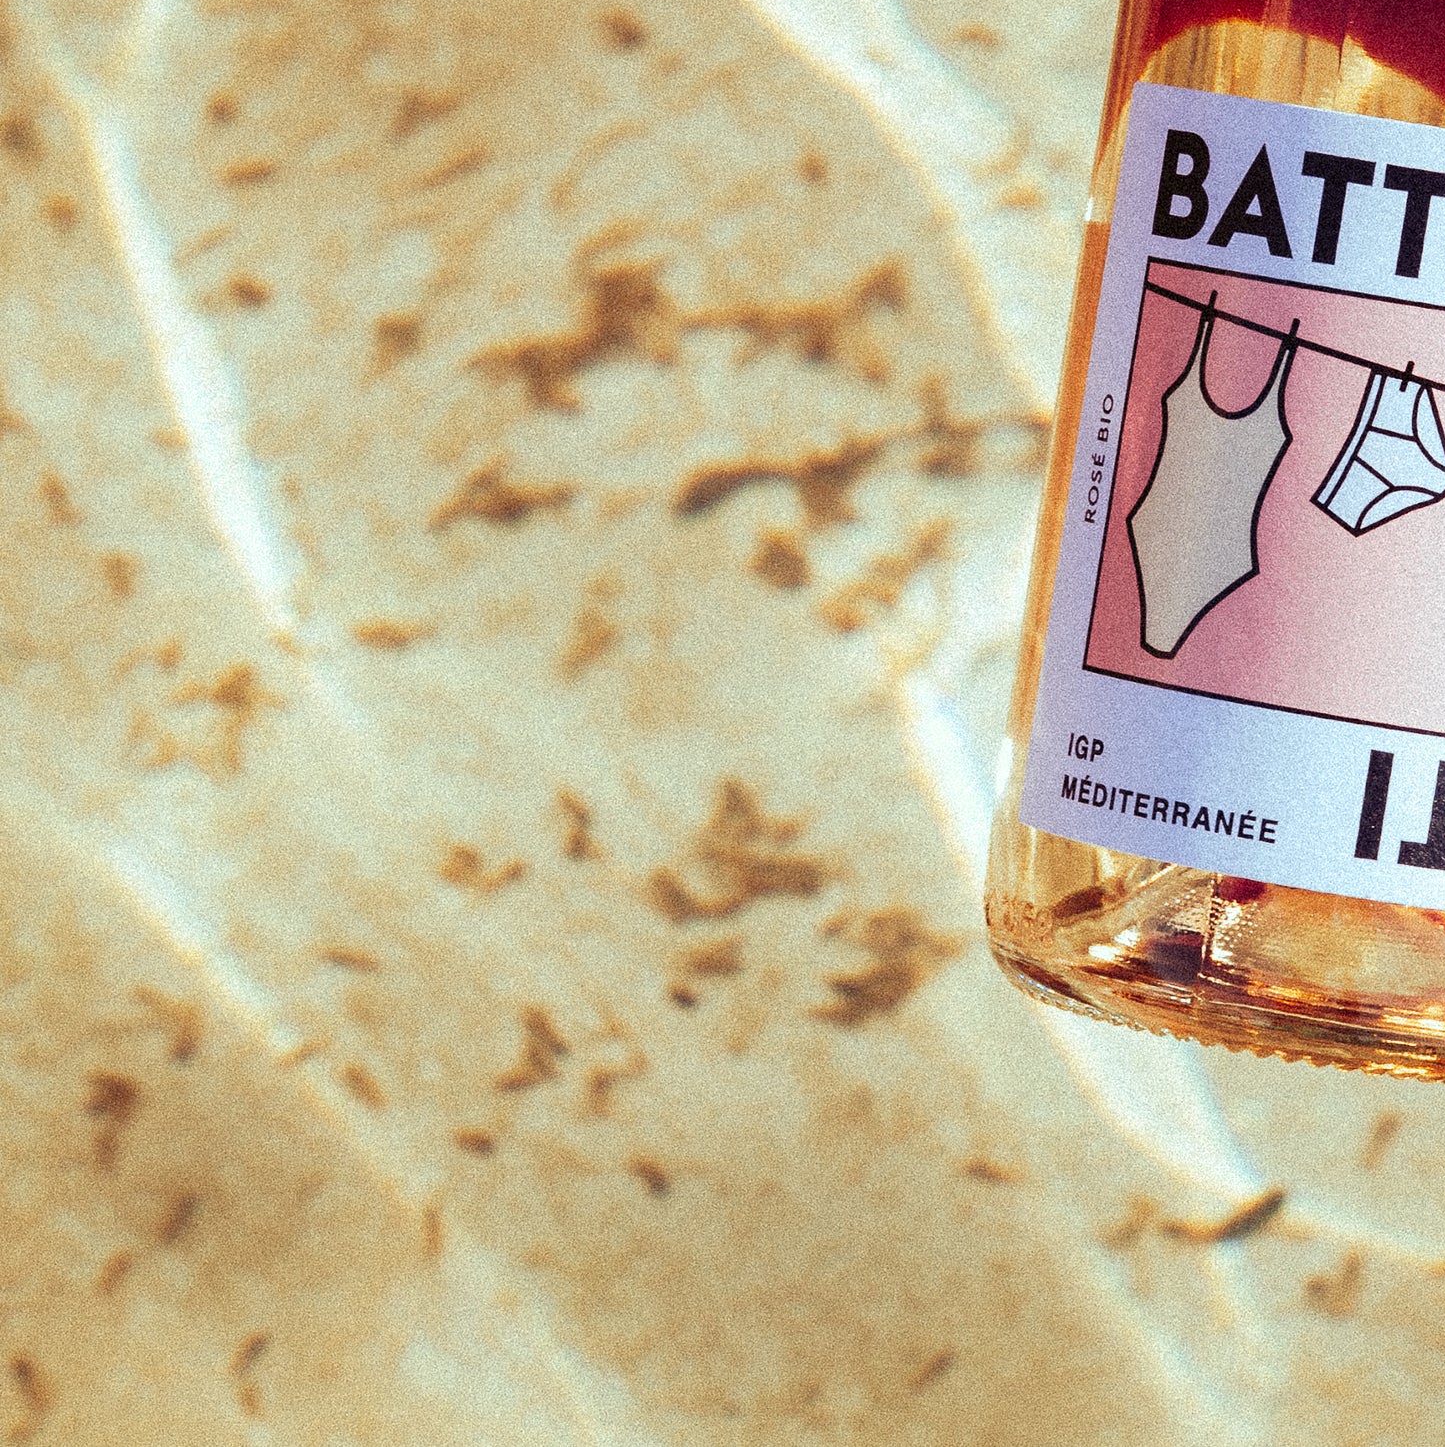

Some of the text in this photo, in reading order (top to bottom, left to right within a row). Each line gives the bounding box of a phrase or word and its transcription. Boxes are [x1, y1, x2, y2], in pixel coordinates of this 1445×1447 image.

[1084, 394, 1114, 524] ROSÉ BIO
[1067, 732, 1105, 762] IGP
[1061, 774, 1279, 844] MÉDITERRANÉE
